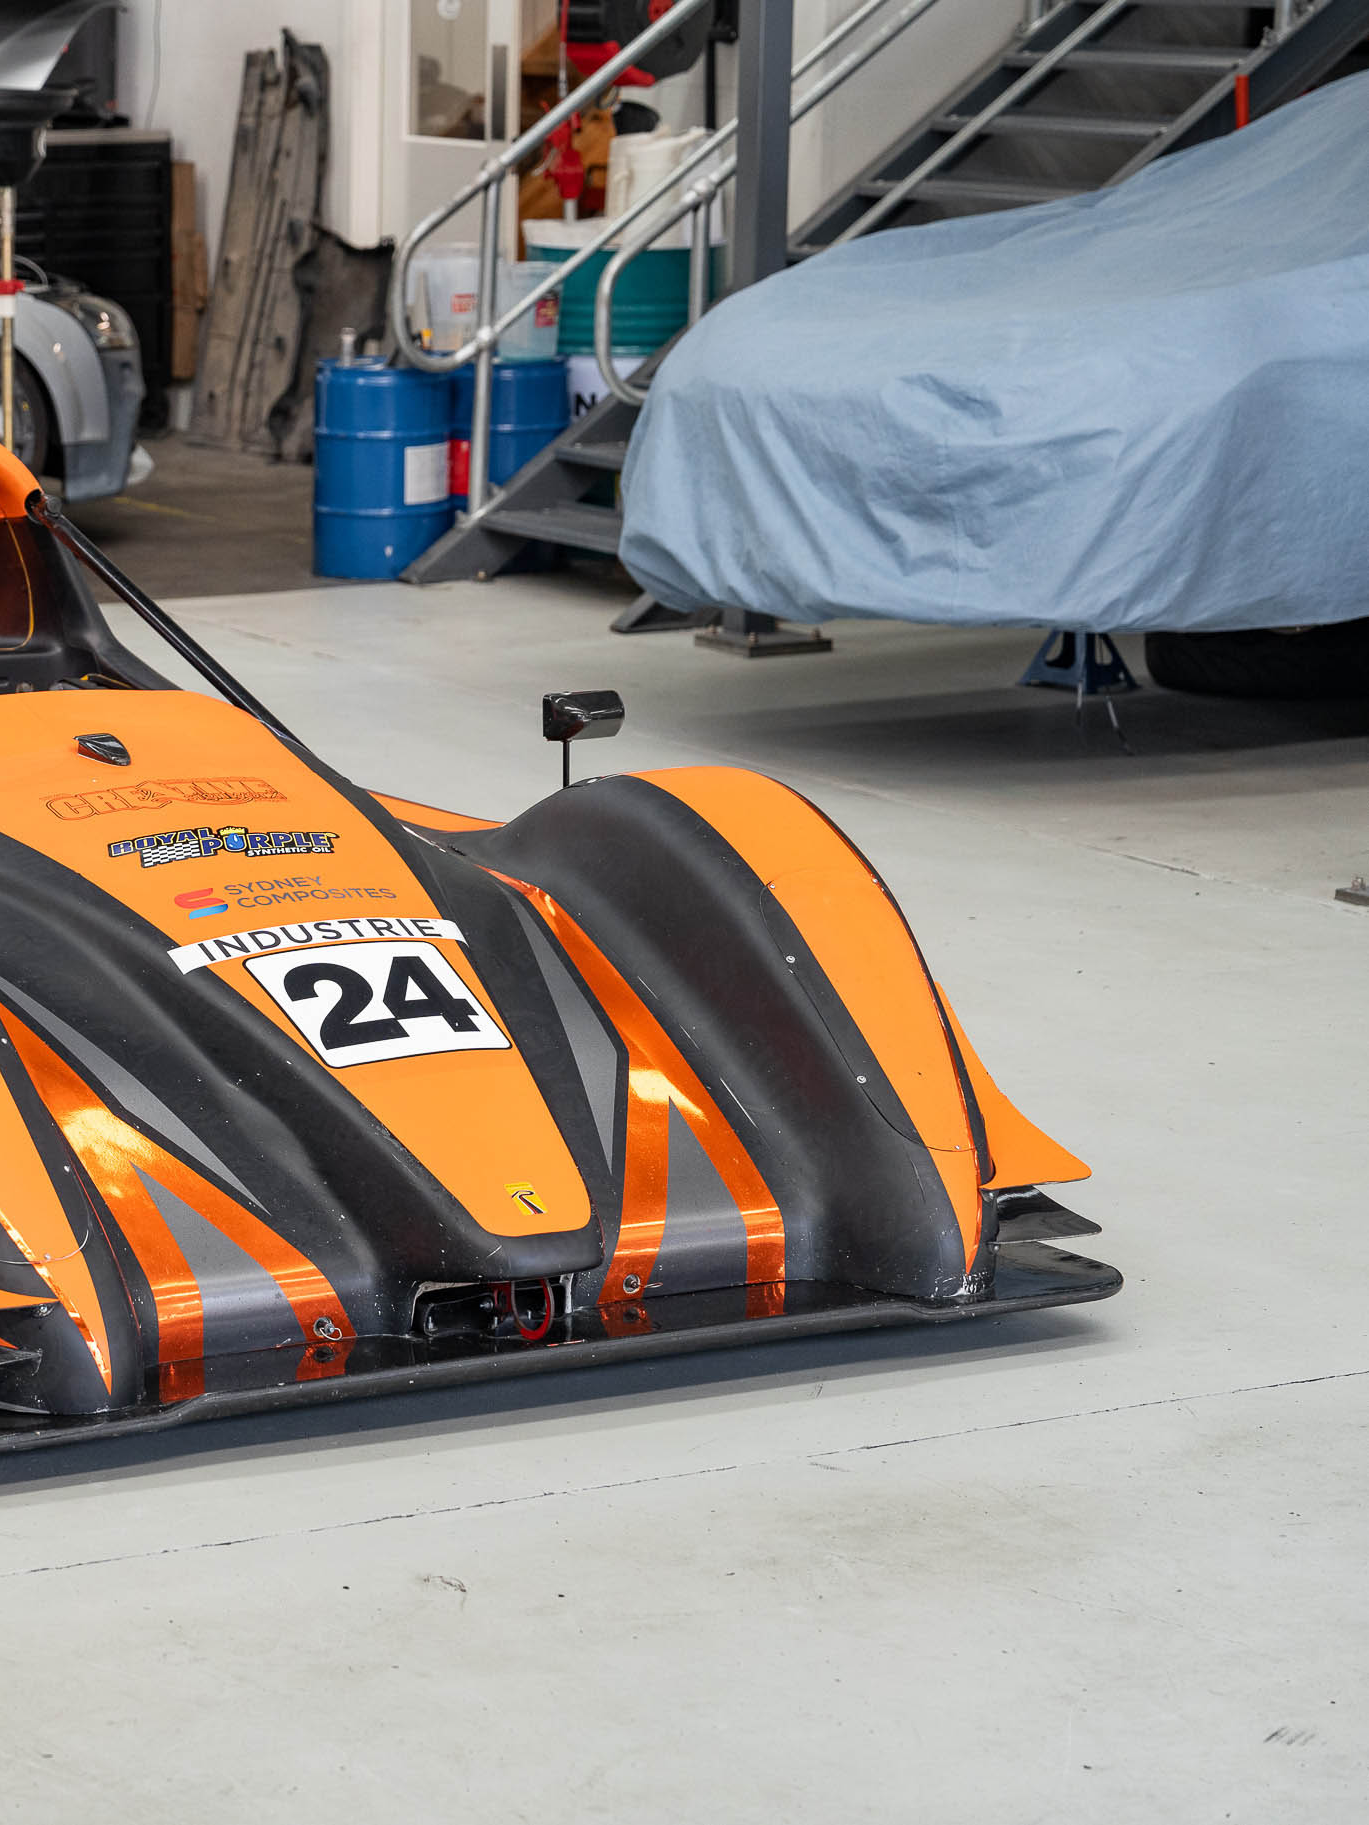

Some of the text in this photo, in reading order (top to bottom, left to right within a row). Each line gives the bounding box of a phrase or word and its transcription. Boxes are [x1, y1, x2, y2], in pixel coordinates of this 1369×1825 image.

[110, 828, 332, 857] ROYAL PURPLE
[247, 847, 308, 857] SYNTHETIC
[224, 875, 323, 896] SYDNEY
[236, 887, 398, 909] COMPOSITES
[197, 918, 443, 963] INDUSTRIE
[283, 955, 482, 1051] 24
